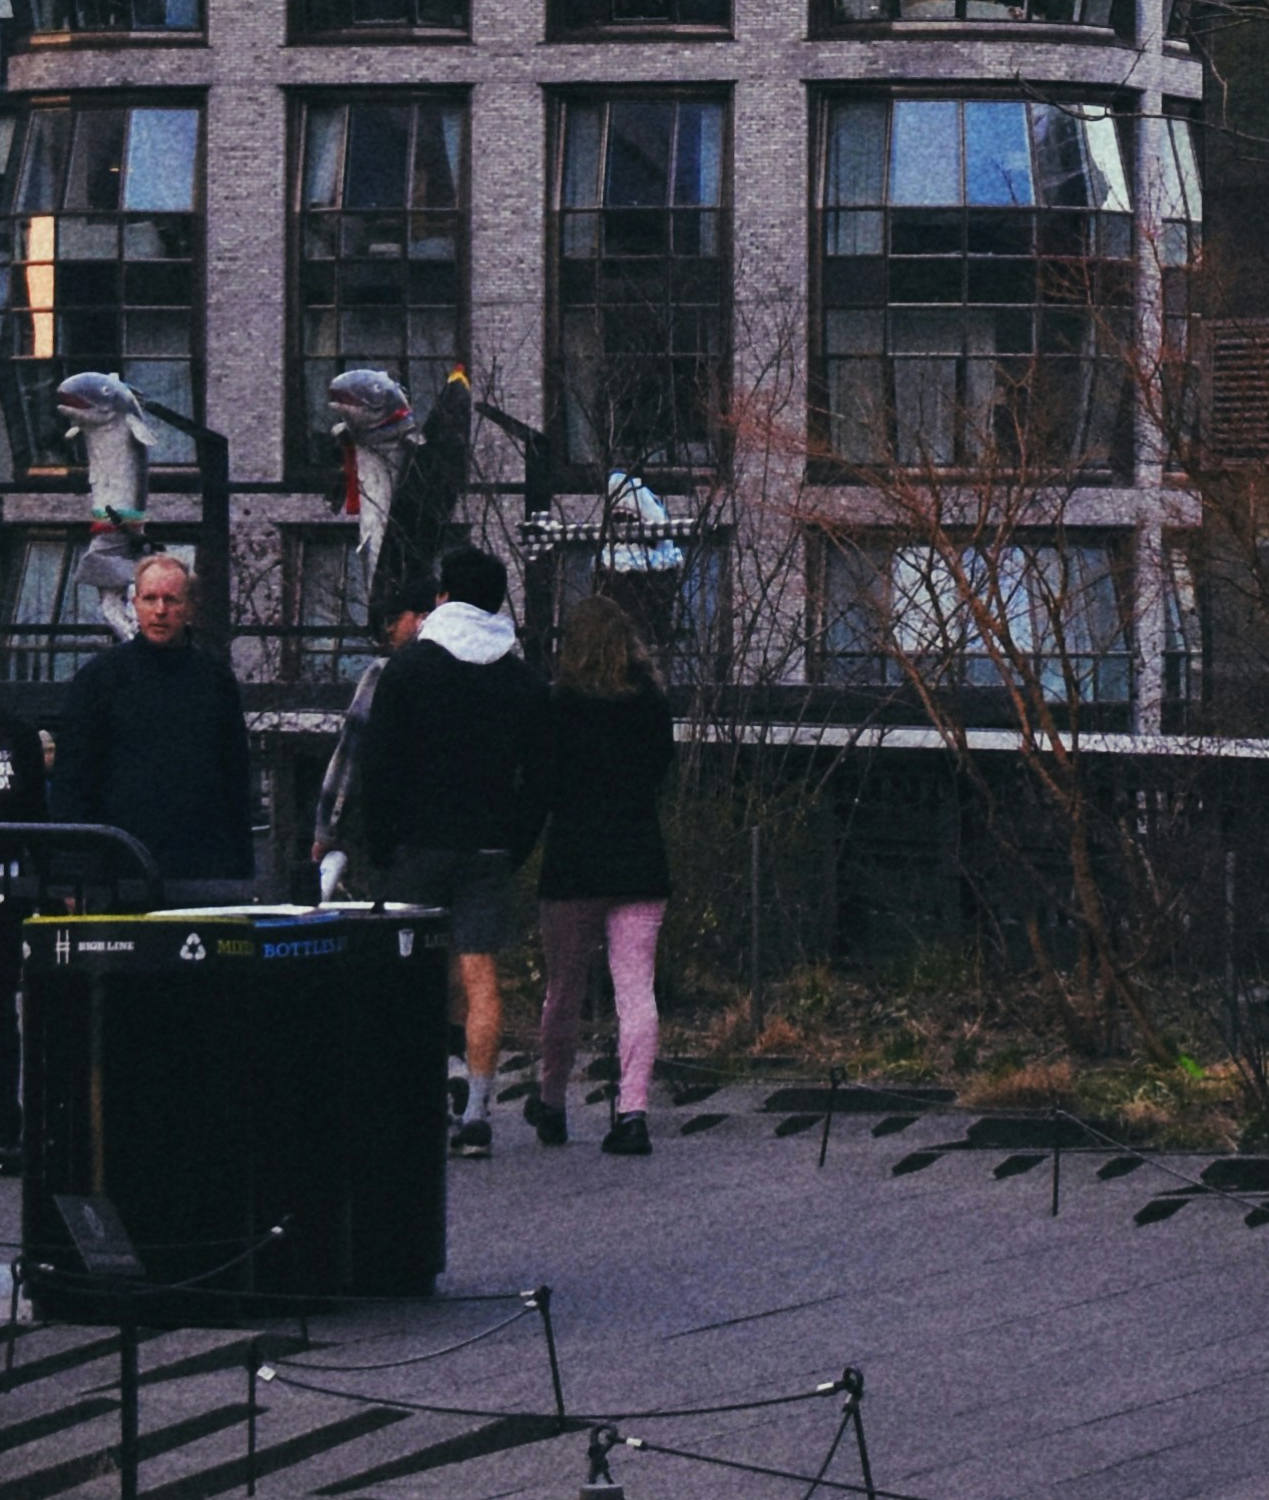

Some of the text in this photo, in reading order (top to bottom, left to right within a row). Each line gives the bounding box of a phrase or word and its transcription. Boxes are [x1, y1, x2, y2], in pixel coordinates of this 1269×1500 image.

[78, 940, 135, 952] HIGH LINE
[263, 937, 335, 959] BOTTLES
